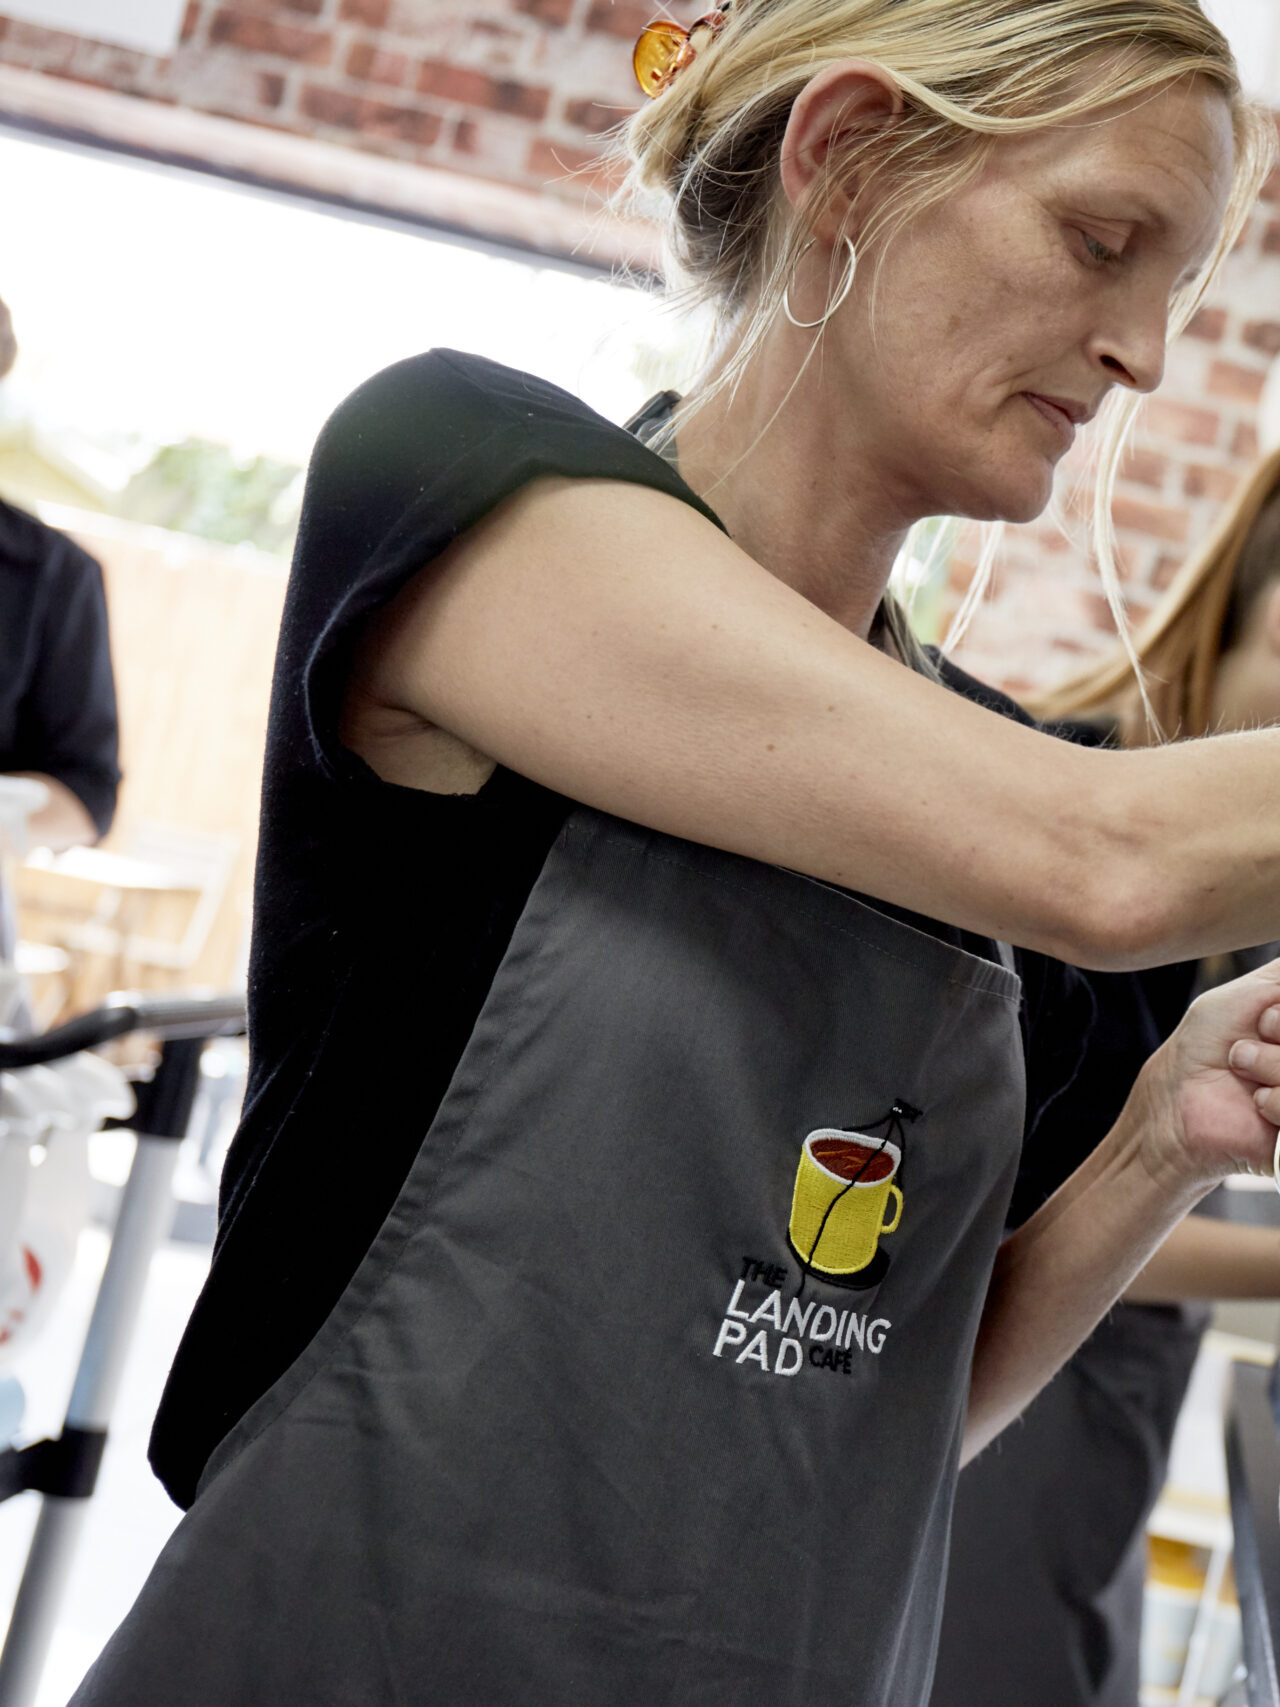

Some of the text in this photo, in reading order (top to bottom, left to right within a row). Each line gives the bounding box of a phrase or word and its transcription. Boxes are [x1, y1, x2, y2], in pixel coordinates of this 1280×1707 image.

[741, 1256, 788, 1289] THE
[726, 1279, 892, 1354] LANDING
[713, 1318, 803, 1376] PAD
